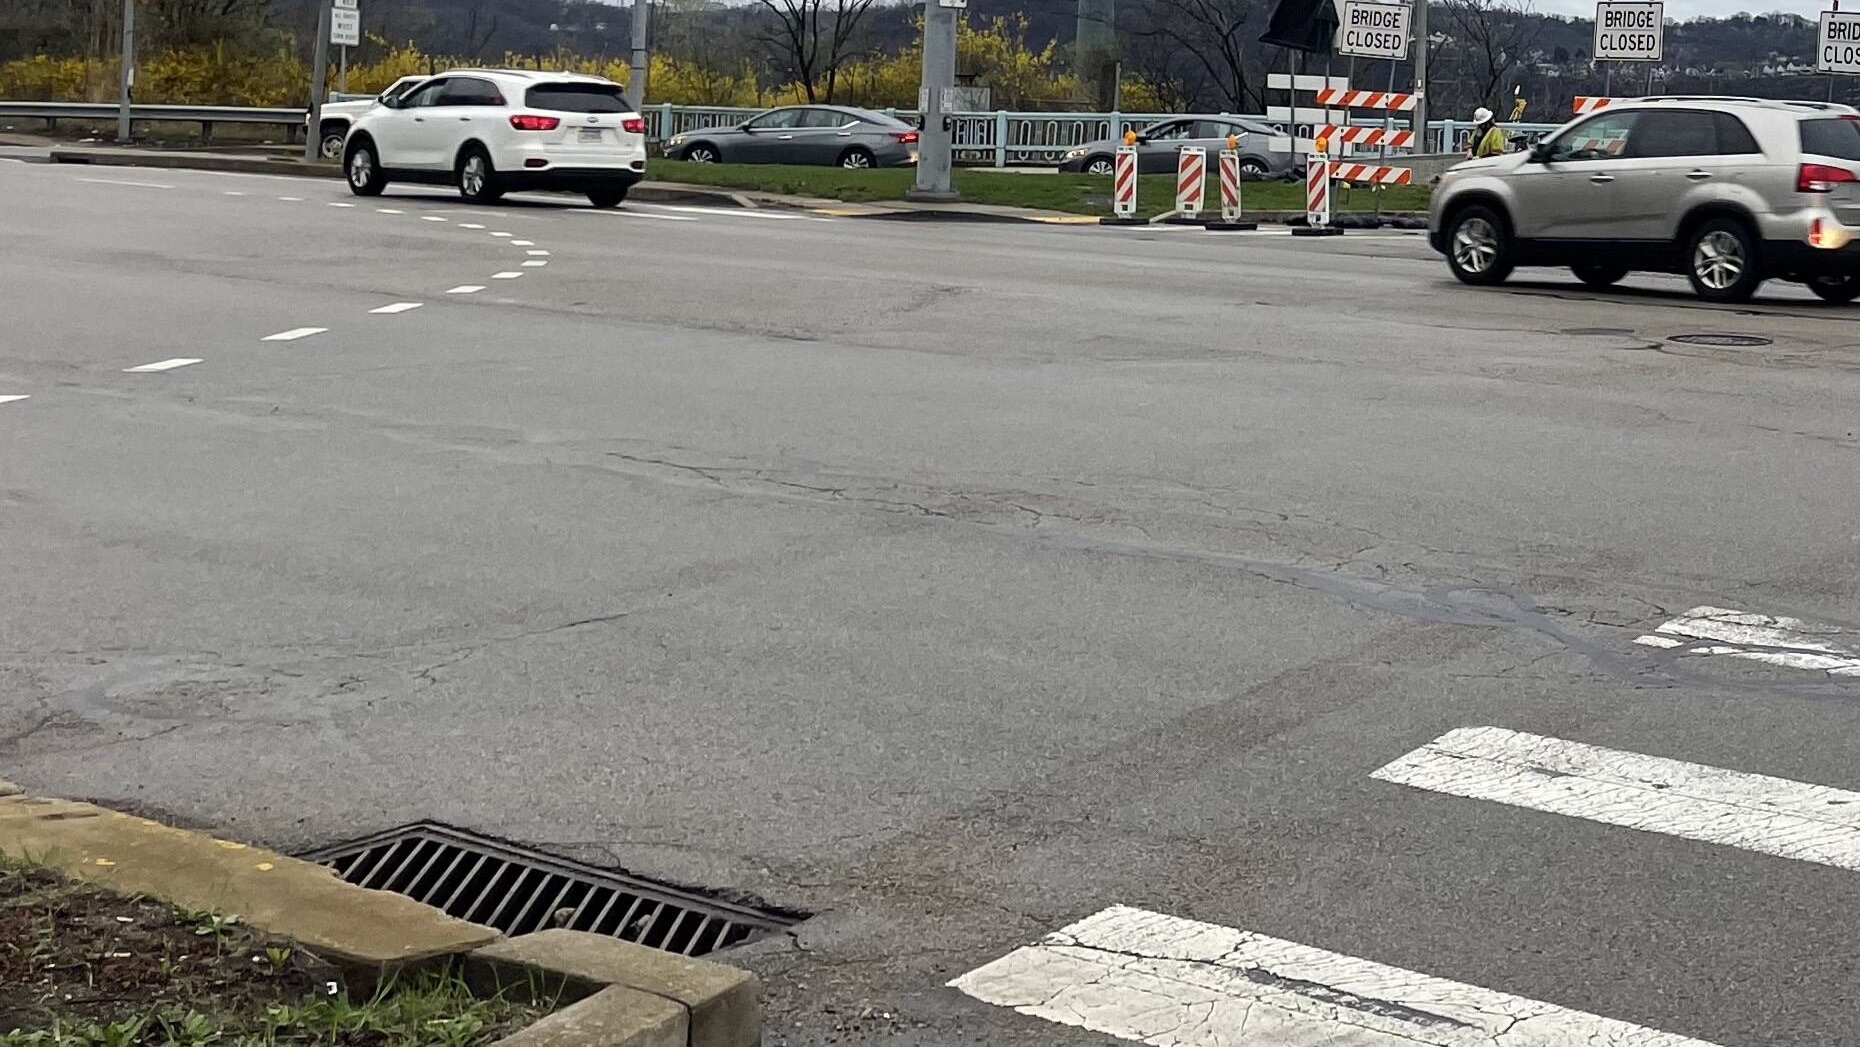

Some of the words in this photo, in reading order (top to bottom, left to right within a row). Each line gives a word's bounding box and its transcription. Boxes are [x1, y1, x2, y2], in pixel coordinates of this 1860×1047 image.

[1352, 9, 1402, 28] BRIDGE
[1605, 10, 1655, 28] BRIDGE
[1346, 30, 1402, 50] CLOSED
[1600, 34, 1656, 51] CLOSED
